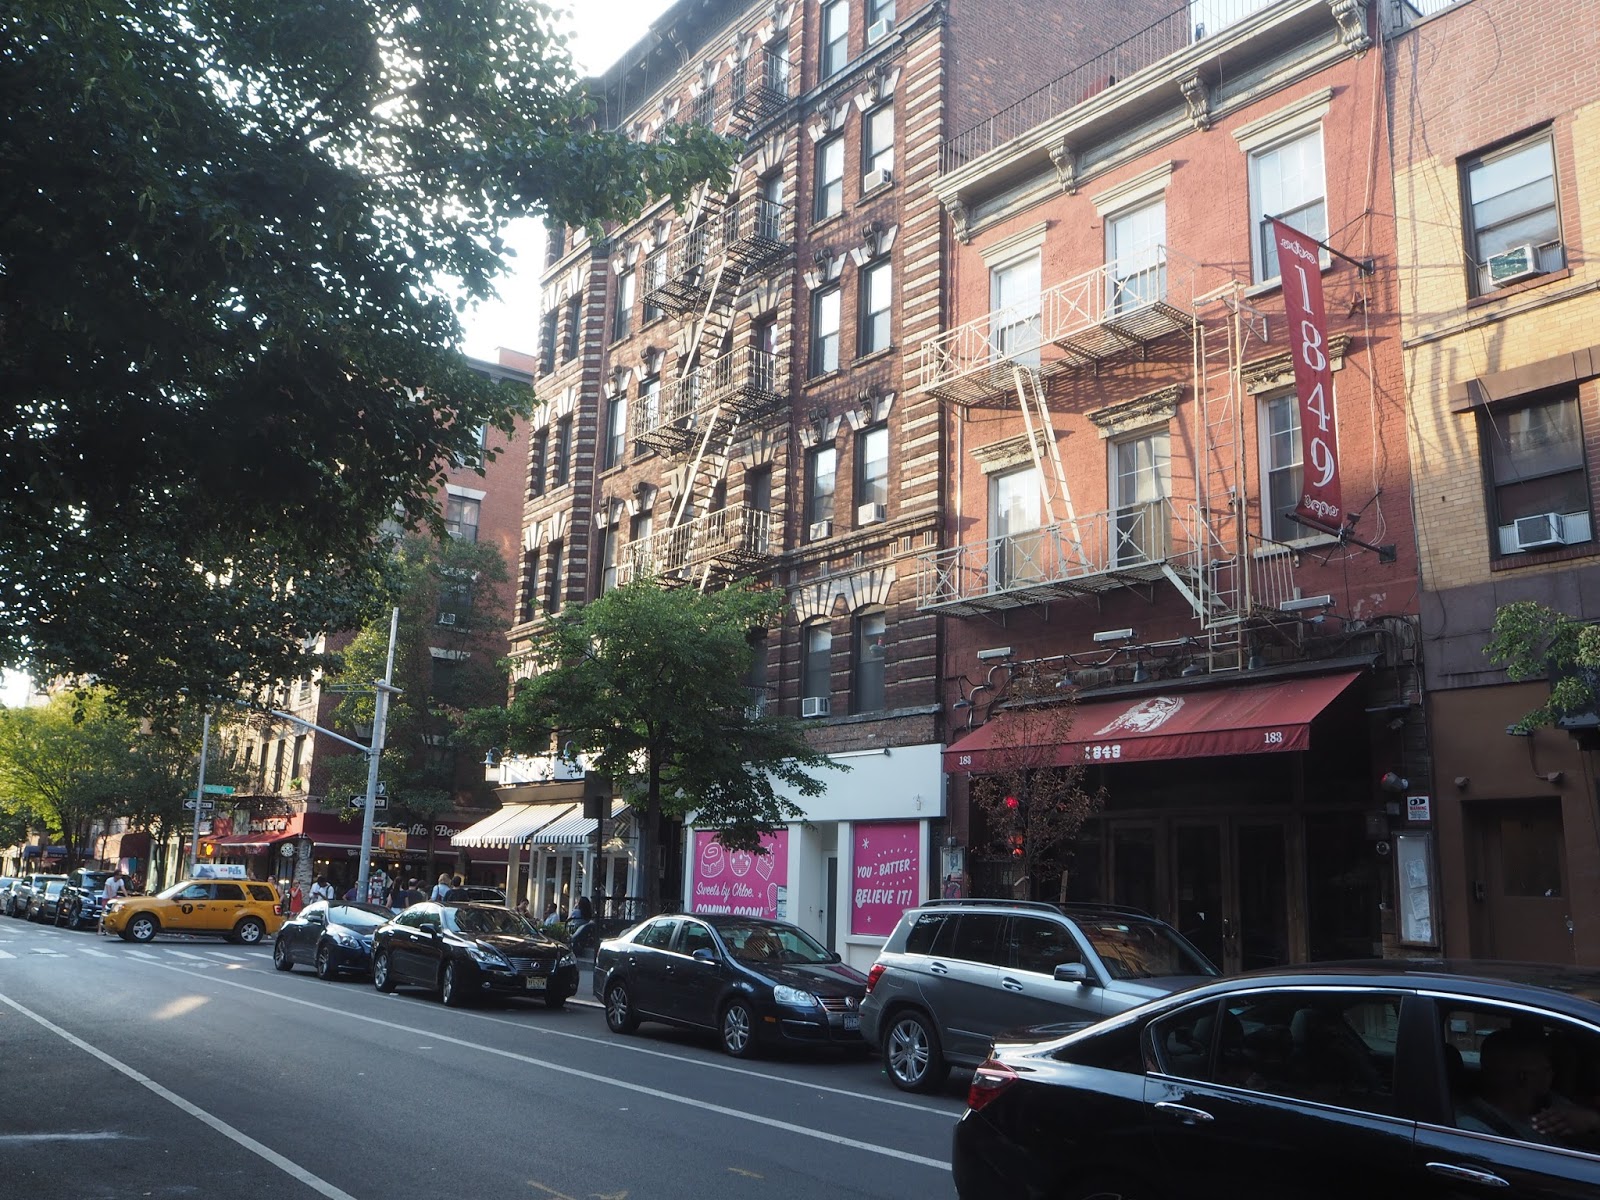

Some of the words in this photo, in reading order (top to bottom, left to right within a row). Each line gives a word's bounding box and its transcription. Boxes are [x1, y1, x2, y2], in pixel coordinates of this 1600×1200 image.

[1295, 264, 1335, 488] 1849
[1264, 731, 1283, 744] 183
[857, 865, 873, 879] YOU
[879, 858, 911, 877] BATTER
[696, 881, 720, 896] Sweets
[720, 881, 731, 903] by
[855, 888, 895, 905] BELIEVE
[896, 889, 913, 906] IT!
